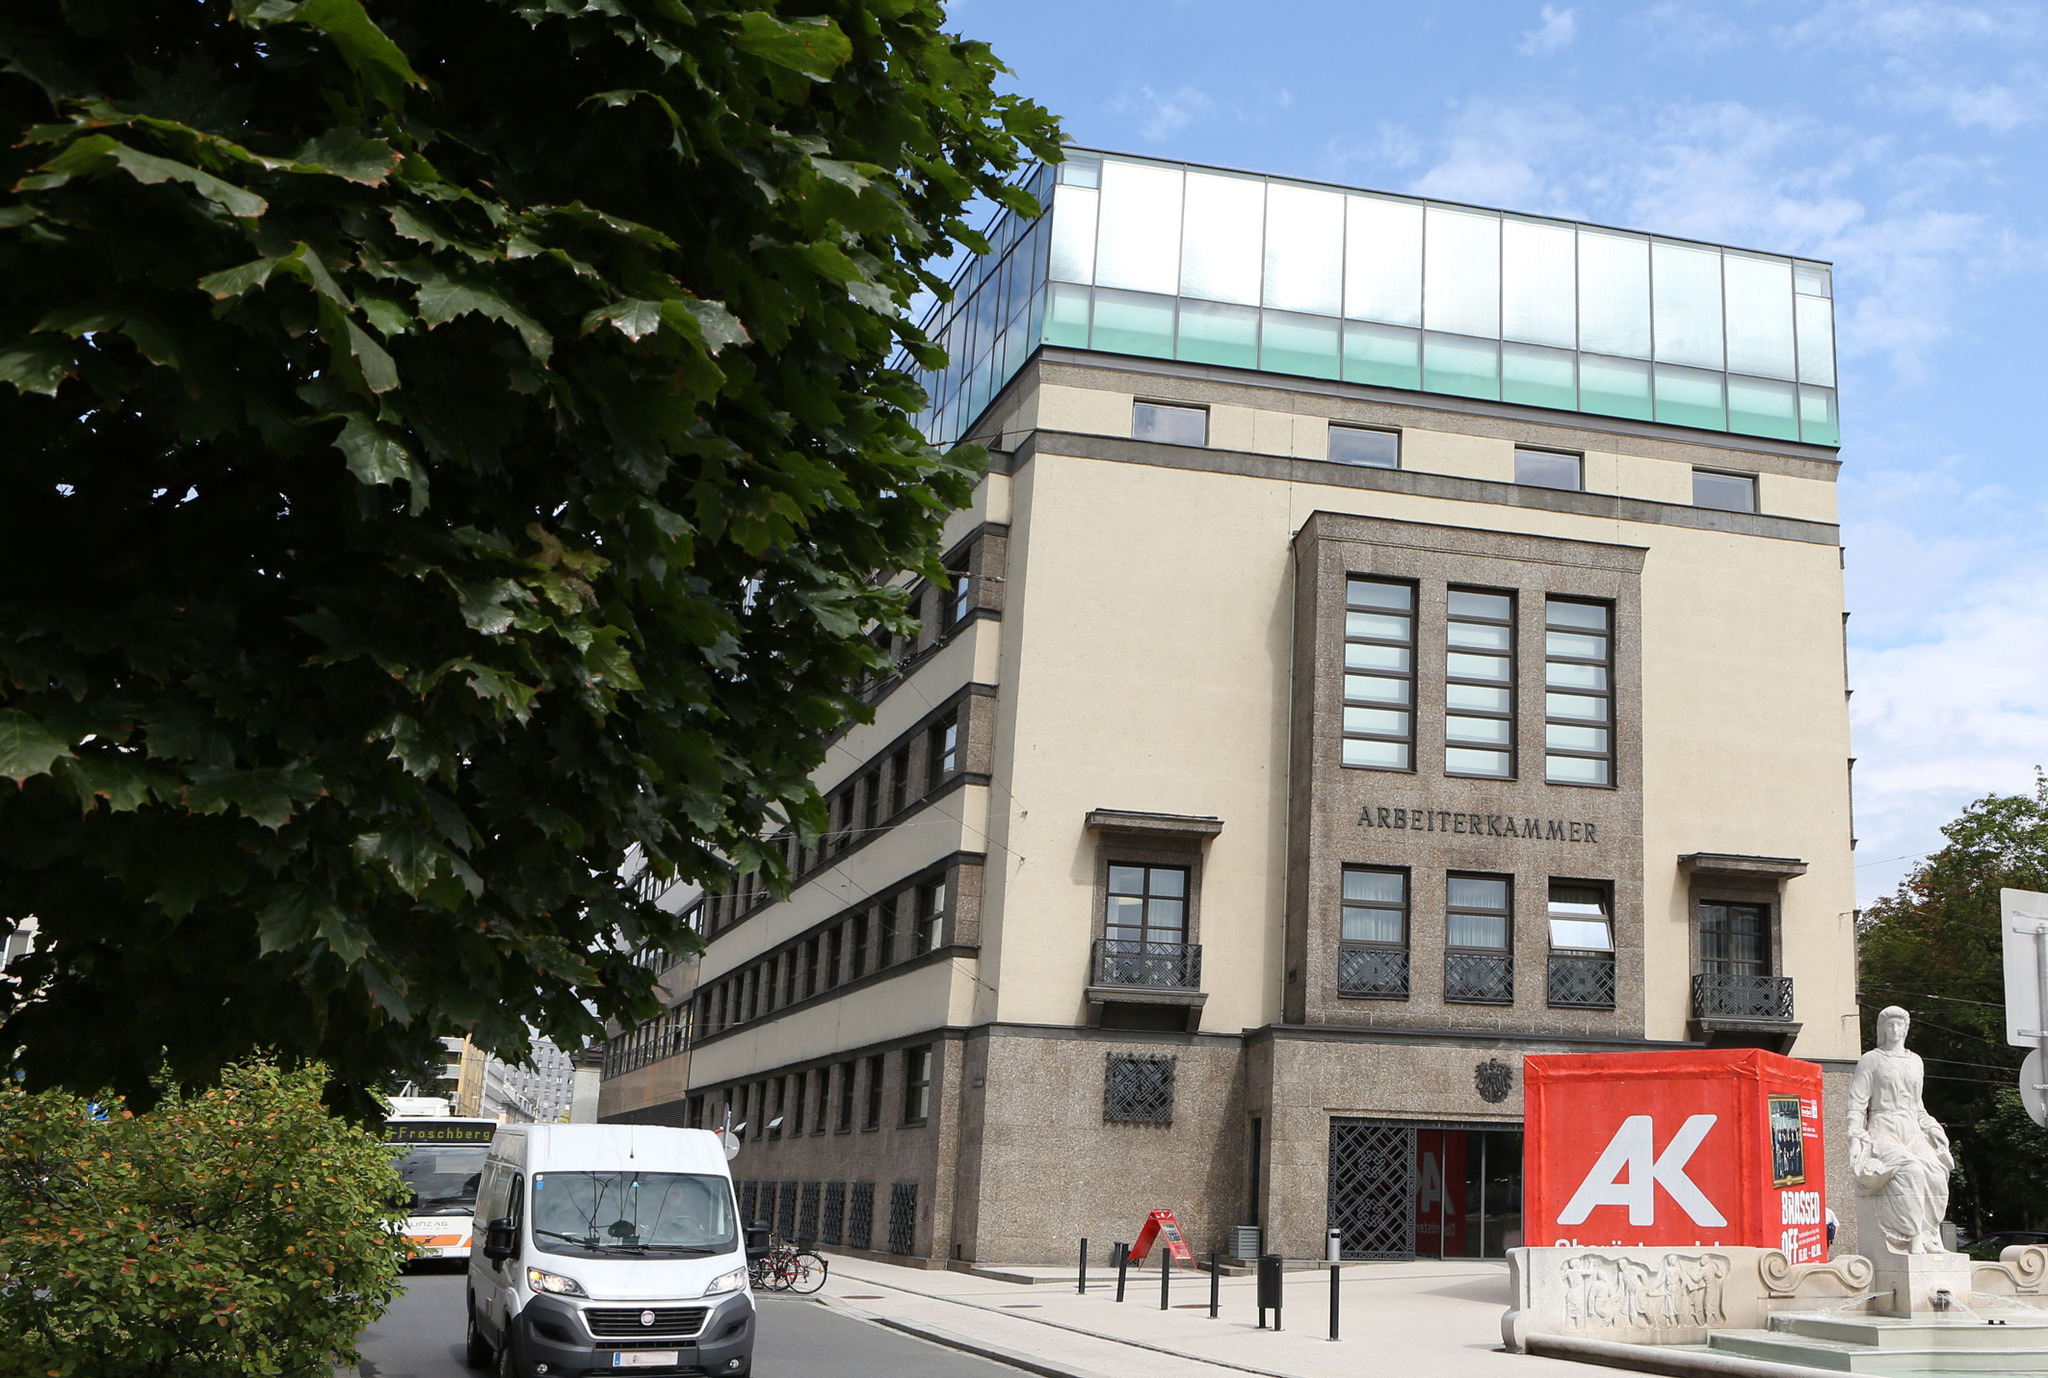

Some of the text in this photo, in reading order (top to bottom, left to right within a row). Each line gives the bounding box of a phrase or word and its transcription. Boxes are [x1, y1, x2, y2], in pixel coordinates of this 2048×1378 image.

[1357, 805, 1598, 843] ARBEITERKAMMER
[1557, 1114, 1728, 1227] AK
[1781, 1190, 1820, 1225] BRASSED
[1781, 1227, 1799, 1265] OFF
